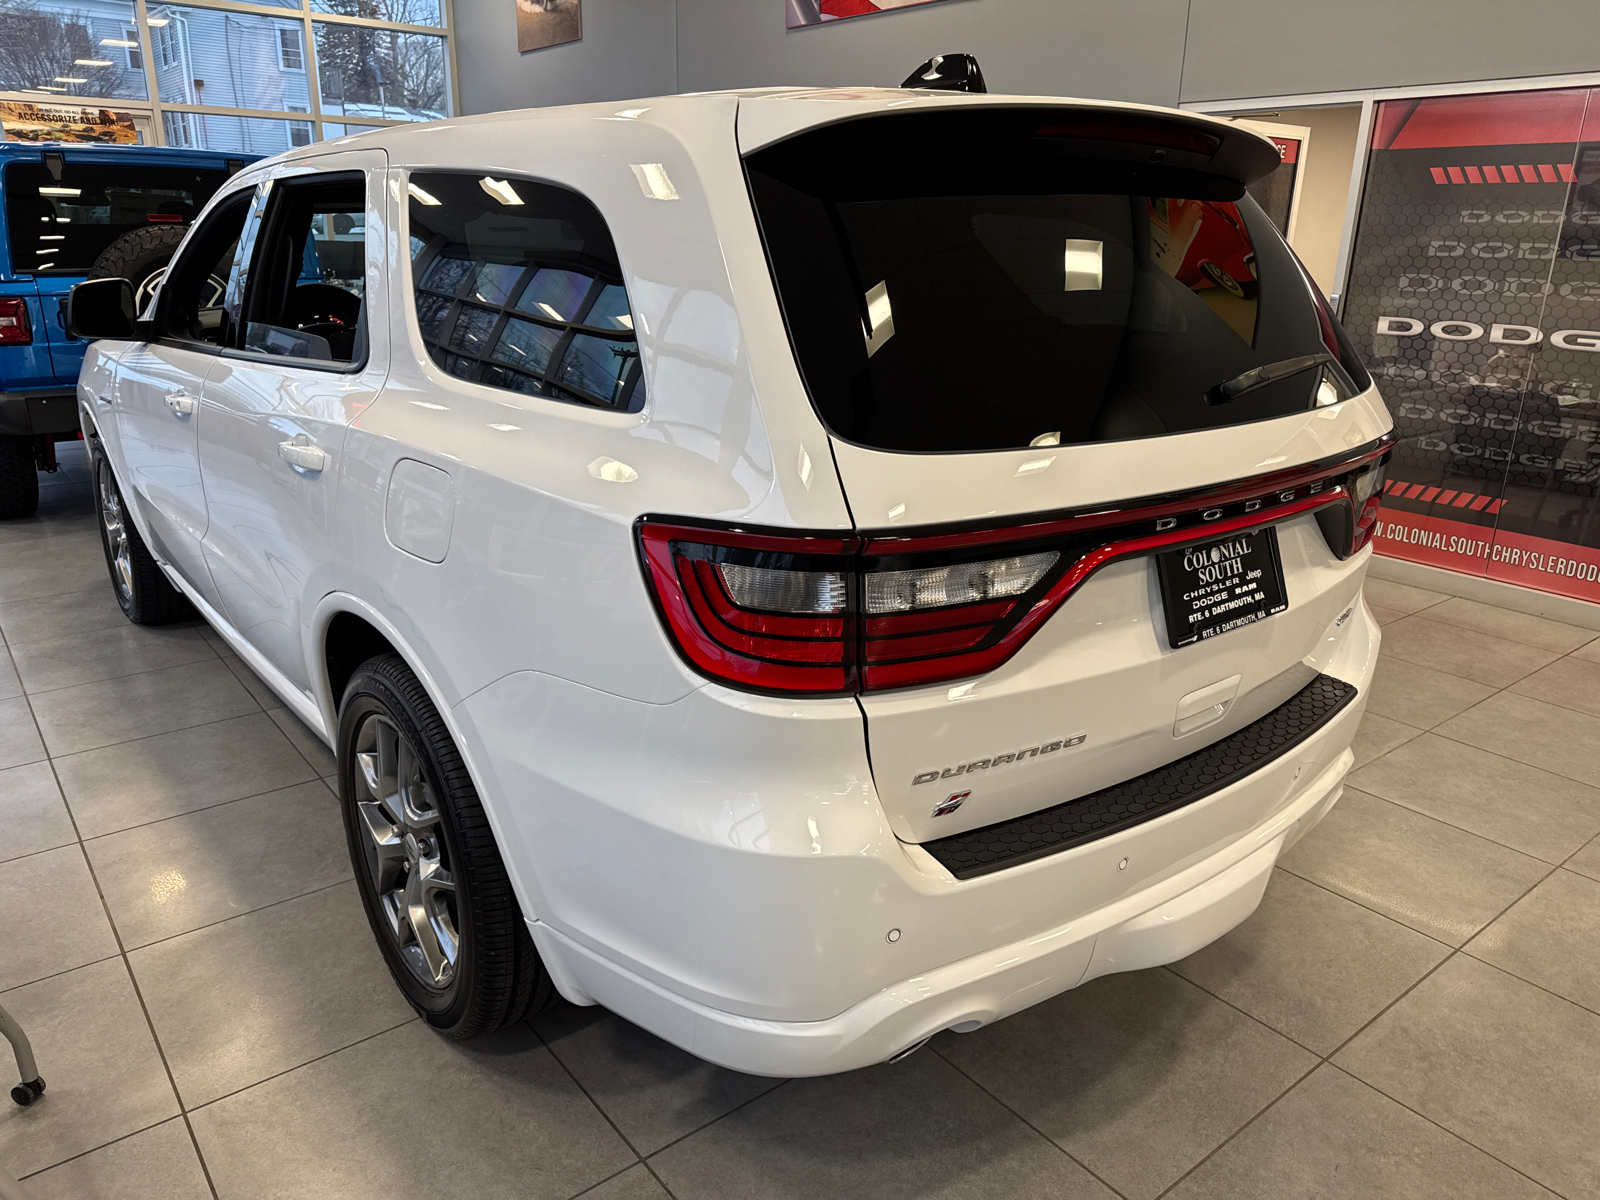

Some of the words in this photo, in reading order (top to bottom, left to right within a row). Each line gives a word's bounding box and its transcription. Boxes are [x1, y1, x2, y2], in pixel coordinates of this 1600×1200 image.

[18, 112, 79, 124] ACCESSORIZE
[80, 116, 97, 125] AND
[1156, 481, 1323, 531] DODGE
[1183, 538, 1252, 571] COLONIAL
[1183, 577, 1240, 600] CHRYSLER
[1246, 569, 1262, 580] Jeep
[1198, 557, 1243, 585] SOUTH
[1188, 612, 1204, 623] RTE.
[1212, 595, 1254, 615] DARTMOUTH,
[1254, 591, 1265, 600] MA
[1192, 591, 1229, 609] DODGE
[1235, 582, 1257, 594] RAM
[1202, 628, 1216, 639] RTE.
[1216, 626, 1221, 634] 6
[1222, 613, 1258, 632] DARTMOUTH,
[1257, 610, 1267, 619] MA
[1270, 604, 1286, 614] RAM
[912, 733, 1087, 785] DURANGO
